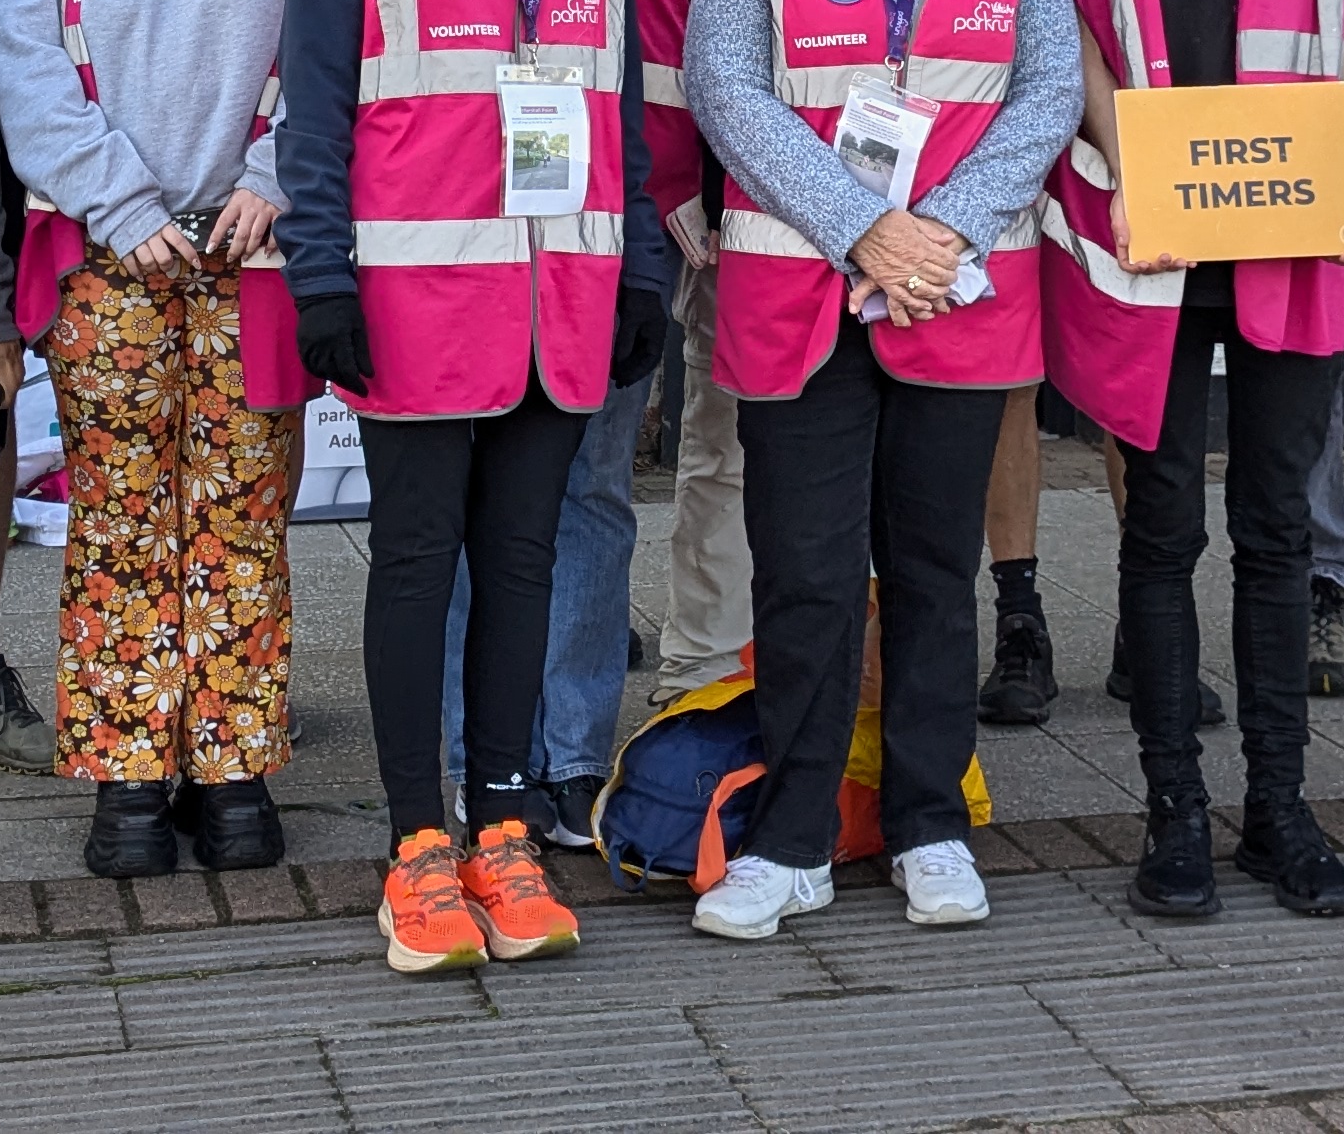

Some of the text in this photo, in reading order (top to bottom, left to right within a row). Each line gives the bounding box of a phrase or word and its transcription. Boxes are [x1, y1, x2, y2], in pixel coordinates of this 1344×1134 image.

[428, 24, 500, 38] VOLUNTEER
[794, 33, 867, 49] VOLUNTEER
[1189, 137, 1293, 166] FIRST
[1173, 178, 1316, 210] TIMERS
[318, 410, 356, 426] park
[328, 433, 363, 448] Adu
